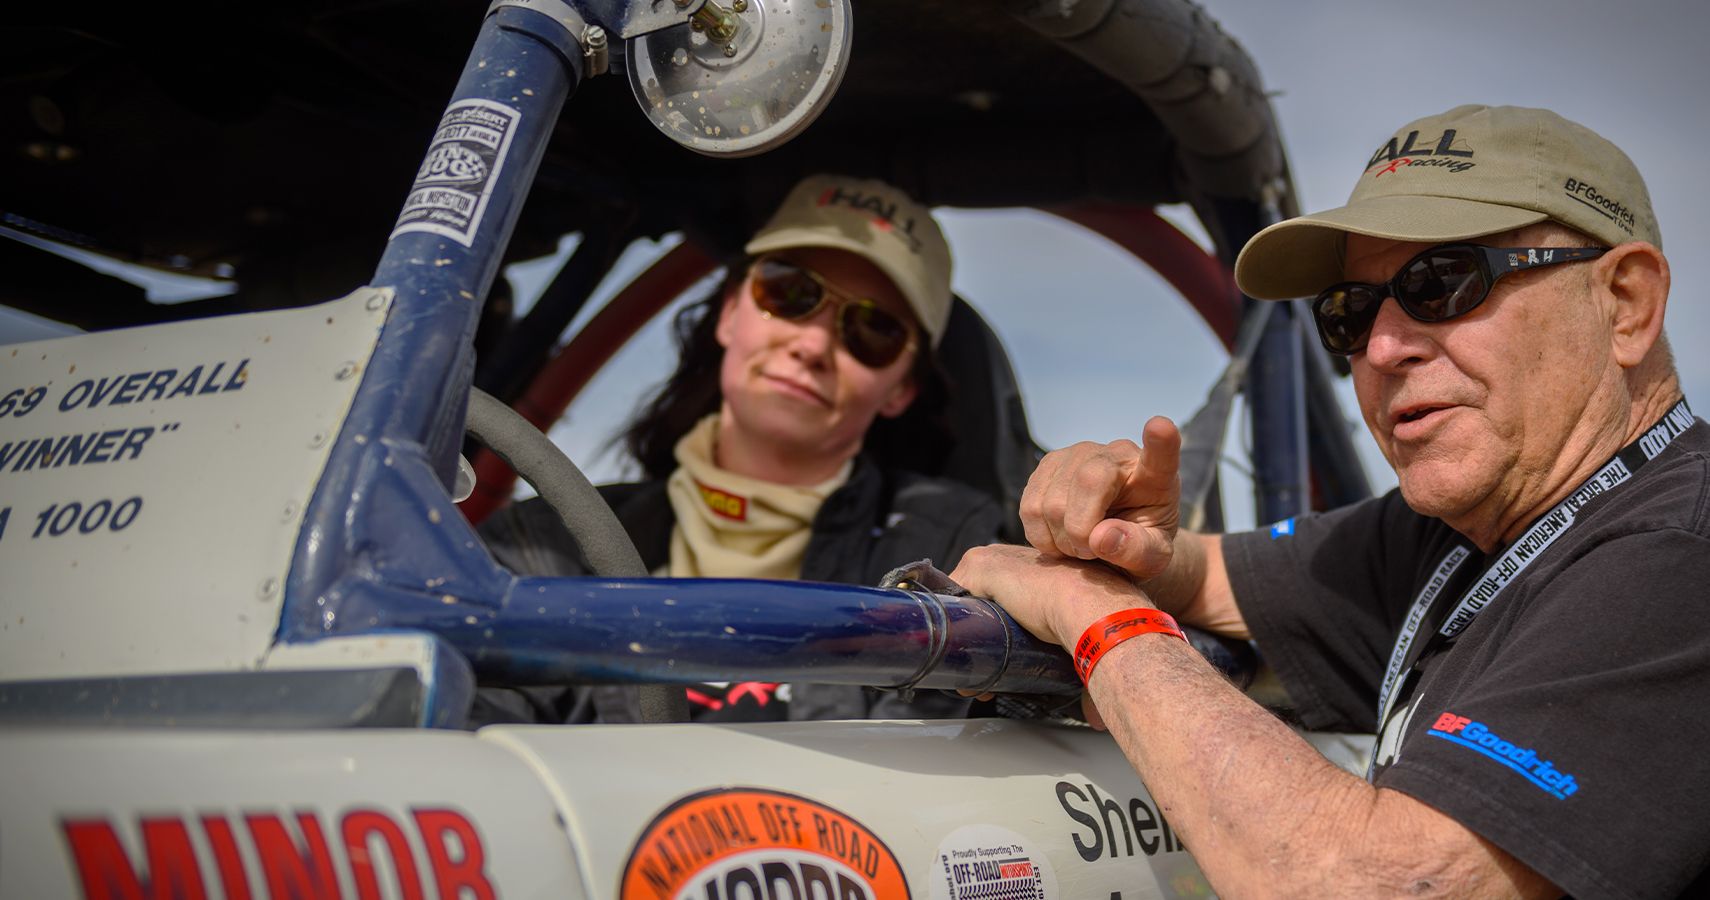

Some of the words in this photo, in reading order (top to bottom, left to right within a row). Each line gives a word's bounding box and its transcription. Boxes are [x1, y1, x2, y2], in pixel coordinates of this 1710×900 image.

[443, 126, 470, 139] 2017
[1564, 177, 1635, 228] BFGoodrich
[58, 358, 250, 412] OVERALL
[1639, 423, 1672, 461] 400
[1601, 462, 1628, 489] THE
[31, 496, 143, 539] 1000
[1563, 479, 1607, 518] GREAT
[1514, 508, 1569, 563] AMERICAN
[1406, 577, 1445, 633] OFF-ROAD
[1440, 548, 1466, 578] RACE
[1467, 555, 1520, 611] OFF-ROAD
[1444, 607, 1476, 635] RACE
[1432, 711, 1580, 797] BFGoodrich
[640, 802, 758, 894] NATIONAL
[757, 801, 805, 846] OFF
[811, 812, 880, 880] ROAD
[952, 849, 977, 859] Proudly
[977, 846, 1012, 858] Supporting
[1011, 844, 1024, 853] The
[953, 860, 1001, 885] OFF-ROAD
[1000, 862, 1034, 879] MOTORSPORTS
